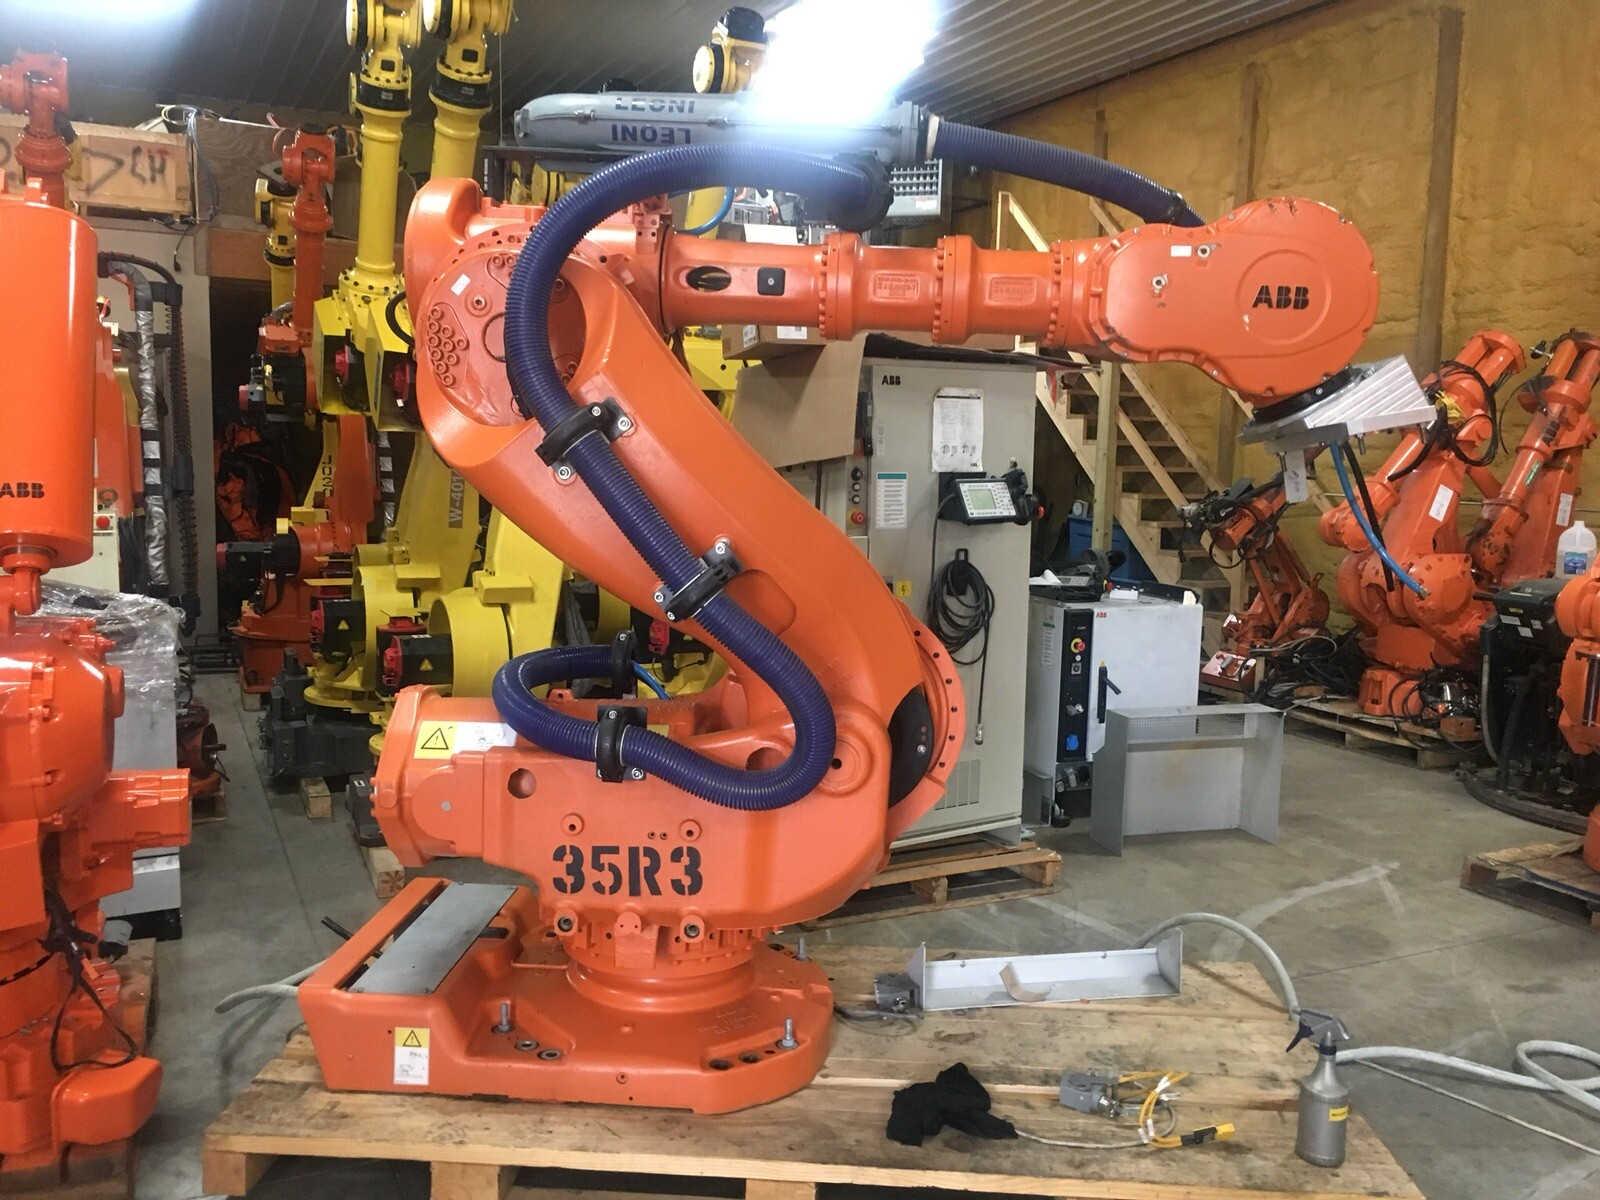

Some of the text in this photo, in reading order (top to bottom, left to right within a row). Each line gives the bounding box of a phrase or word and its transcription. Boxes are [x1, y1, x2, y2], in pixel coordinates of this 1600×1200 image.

[615, 97, 695, 114] LEONI
[611, 123, 691, 145] LEONI
[1252, 285, 1310, 310] ABB
[881, 374, 902, 386] ABB
[0, 482, 45, 499] ABB
[552, 844, 704, 897] 35R3
